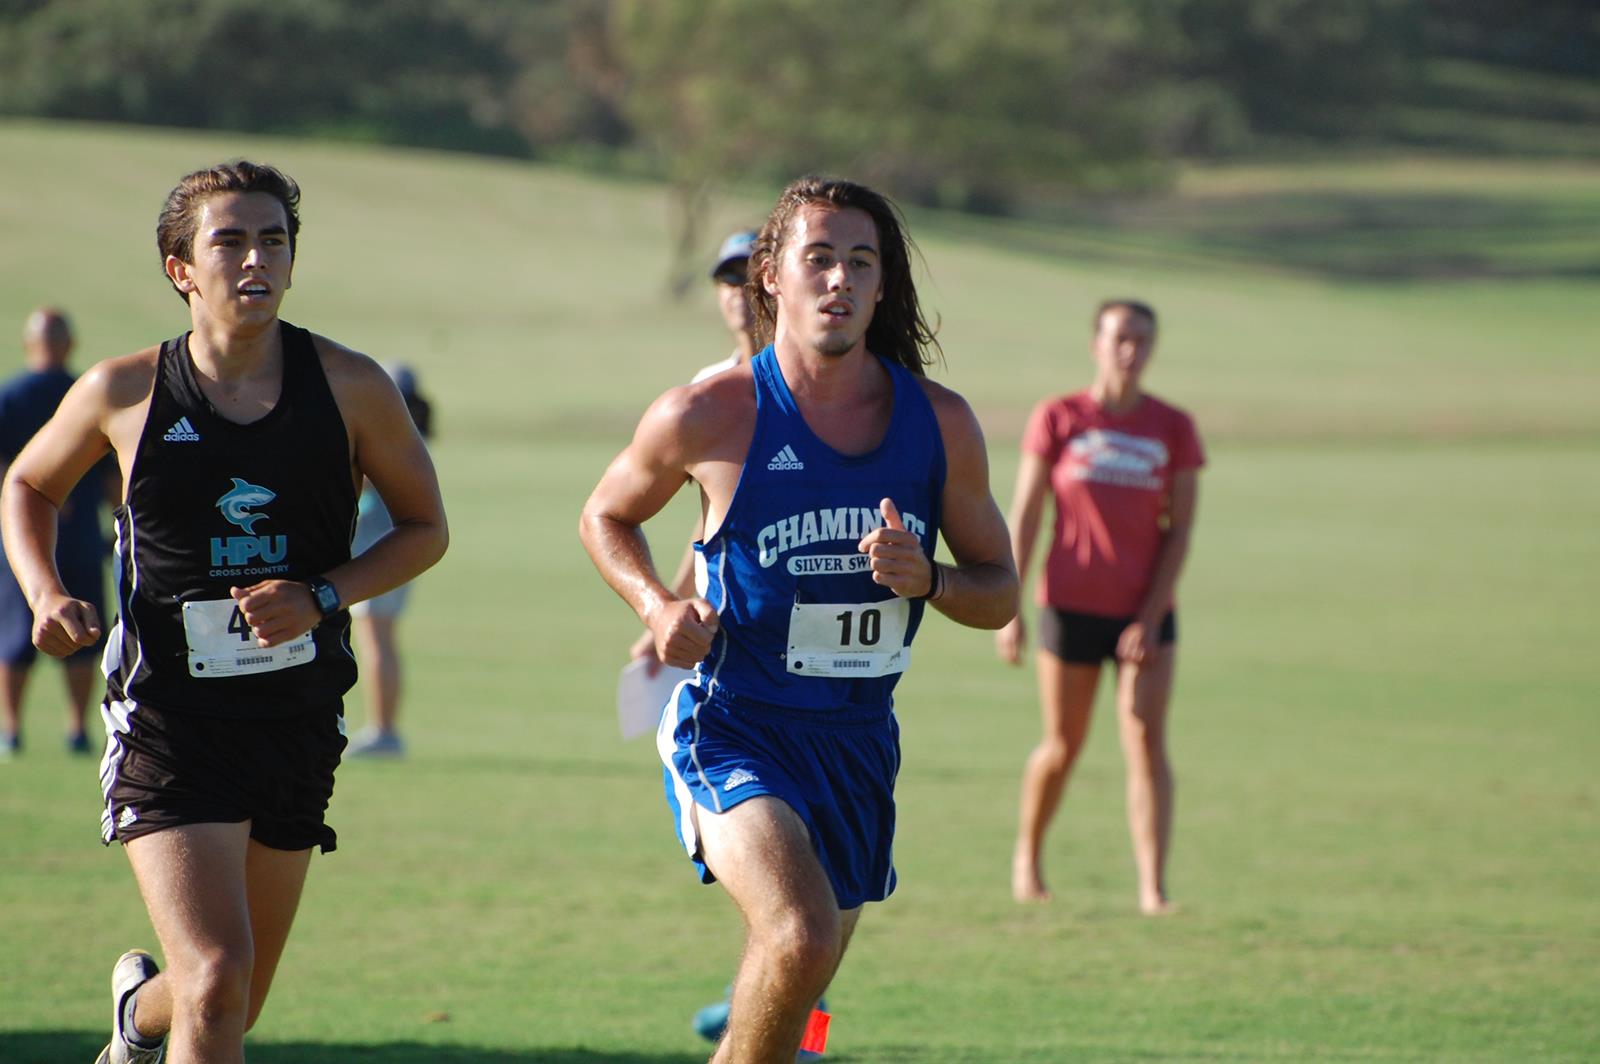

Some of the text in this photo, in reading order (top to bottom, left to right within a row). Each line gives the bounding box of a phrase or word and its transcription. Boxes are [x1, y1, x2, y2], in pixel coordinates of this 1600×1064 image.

[163, 432, 200, 442] adidas
[767, 461, 804, 471] adidas
[756, 507, 926, 569] CHAMIND
[210, 534, 288, 567] HPU
[208, 564, 289, 577] CROSS COUNTRY
[794, 557, 844, 573] SILVER
[227, 604, 252, 642] 4
[836, 608, 882, 647] 10
